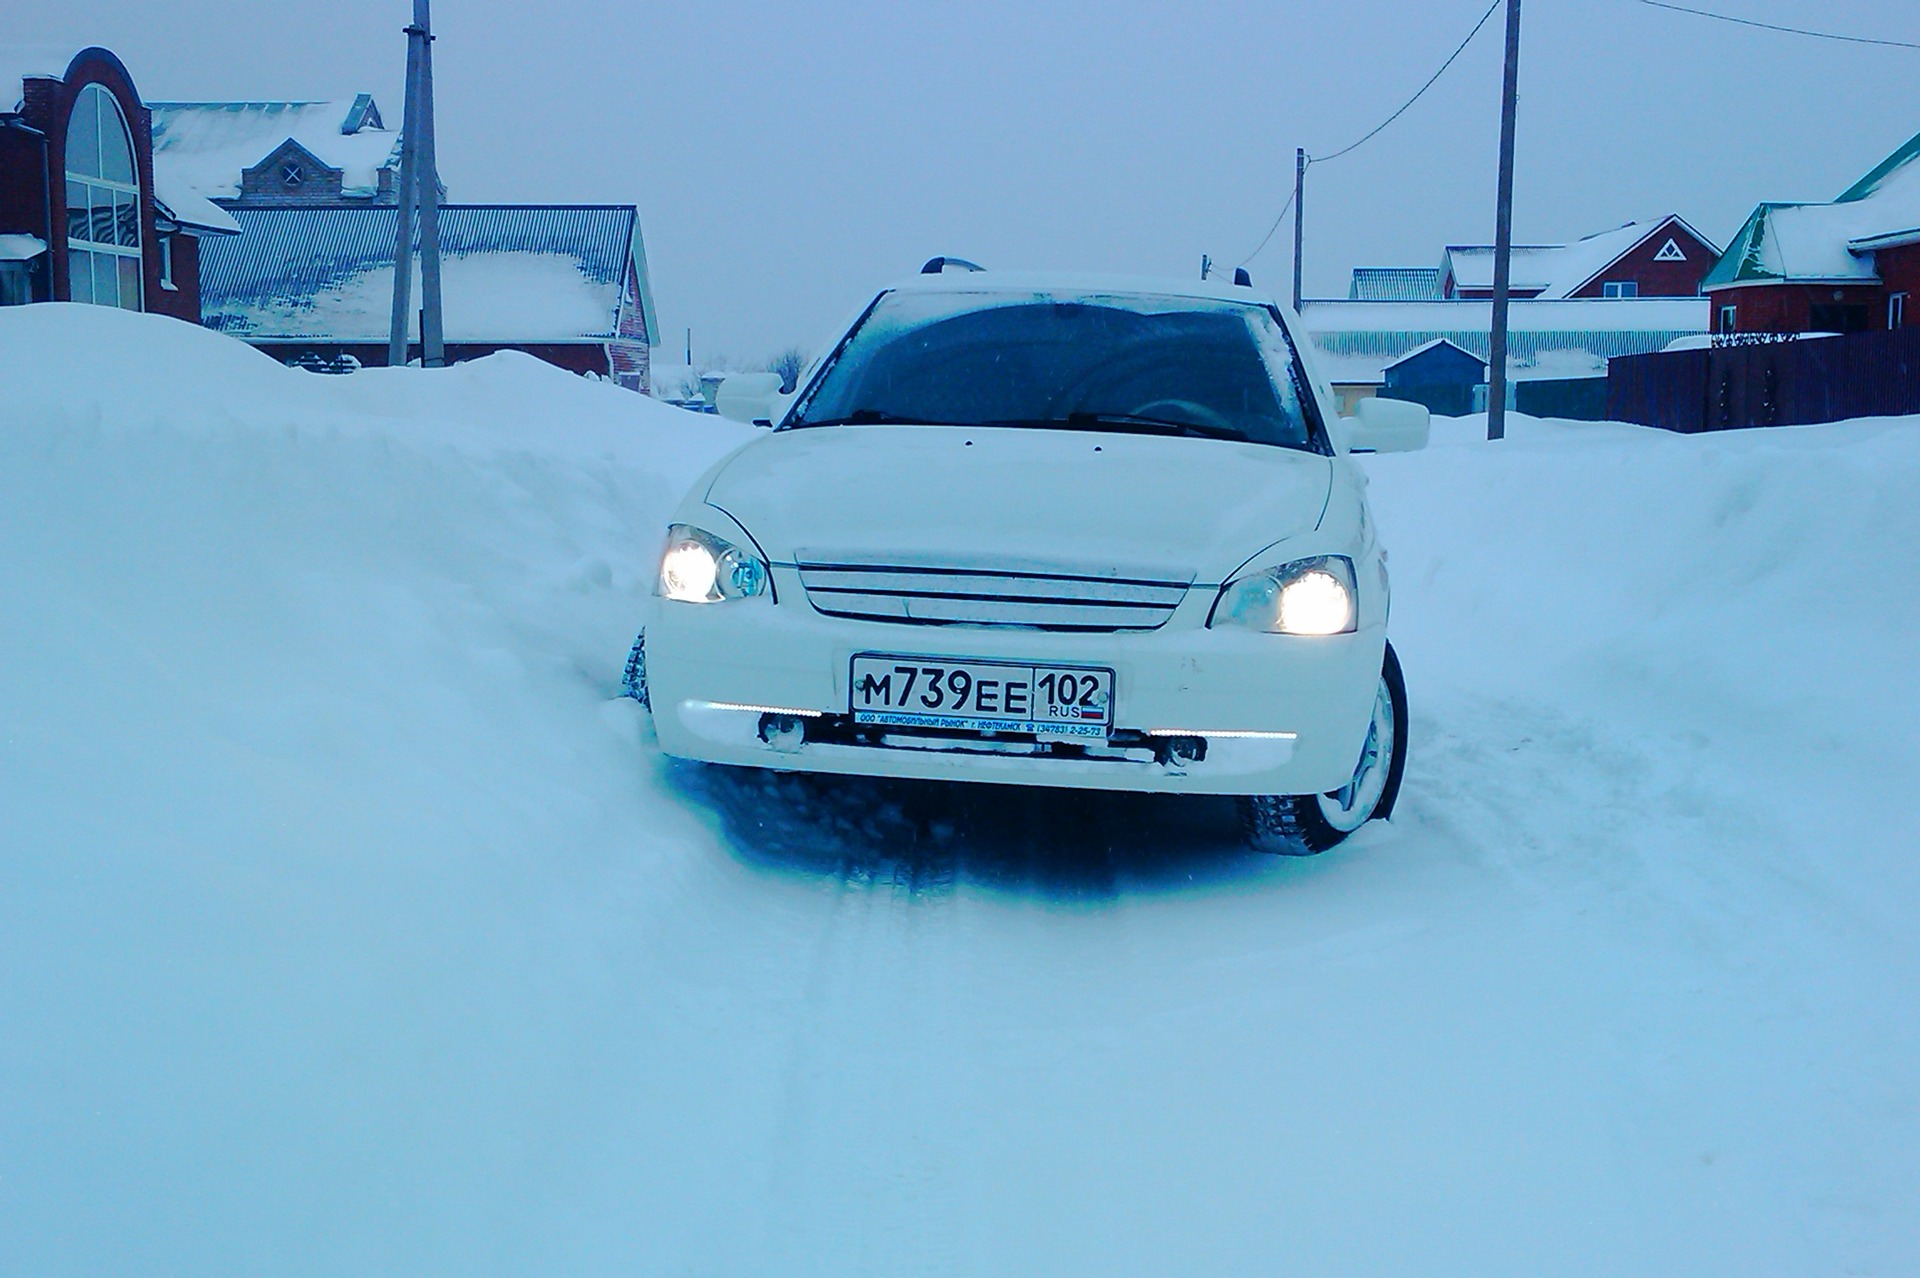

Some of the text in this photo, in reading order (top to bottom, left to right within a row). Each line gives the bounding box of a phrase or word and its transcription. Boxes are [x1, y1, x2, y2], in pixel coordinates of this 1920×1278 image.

[864, 666, 1100, 714] М739ЕЕ 102
[1049, 705, 1080, 718] RUS
[860, 714, 875, 723] ООО
[977, 721, 1020, 731] НЕФТЕКАМСК
[1036, 723, 1068, 733] (34783)
[1069, 726, 1101, 735] 2-25-73
